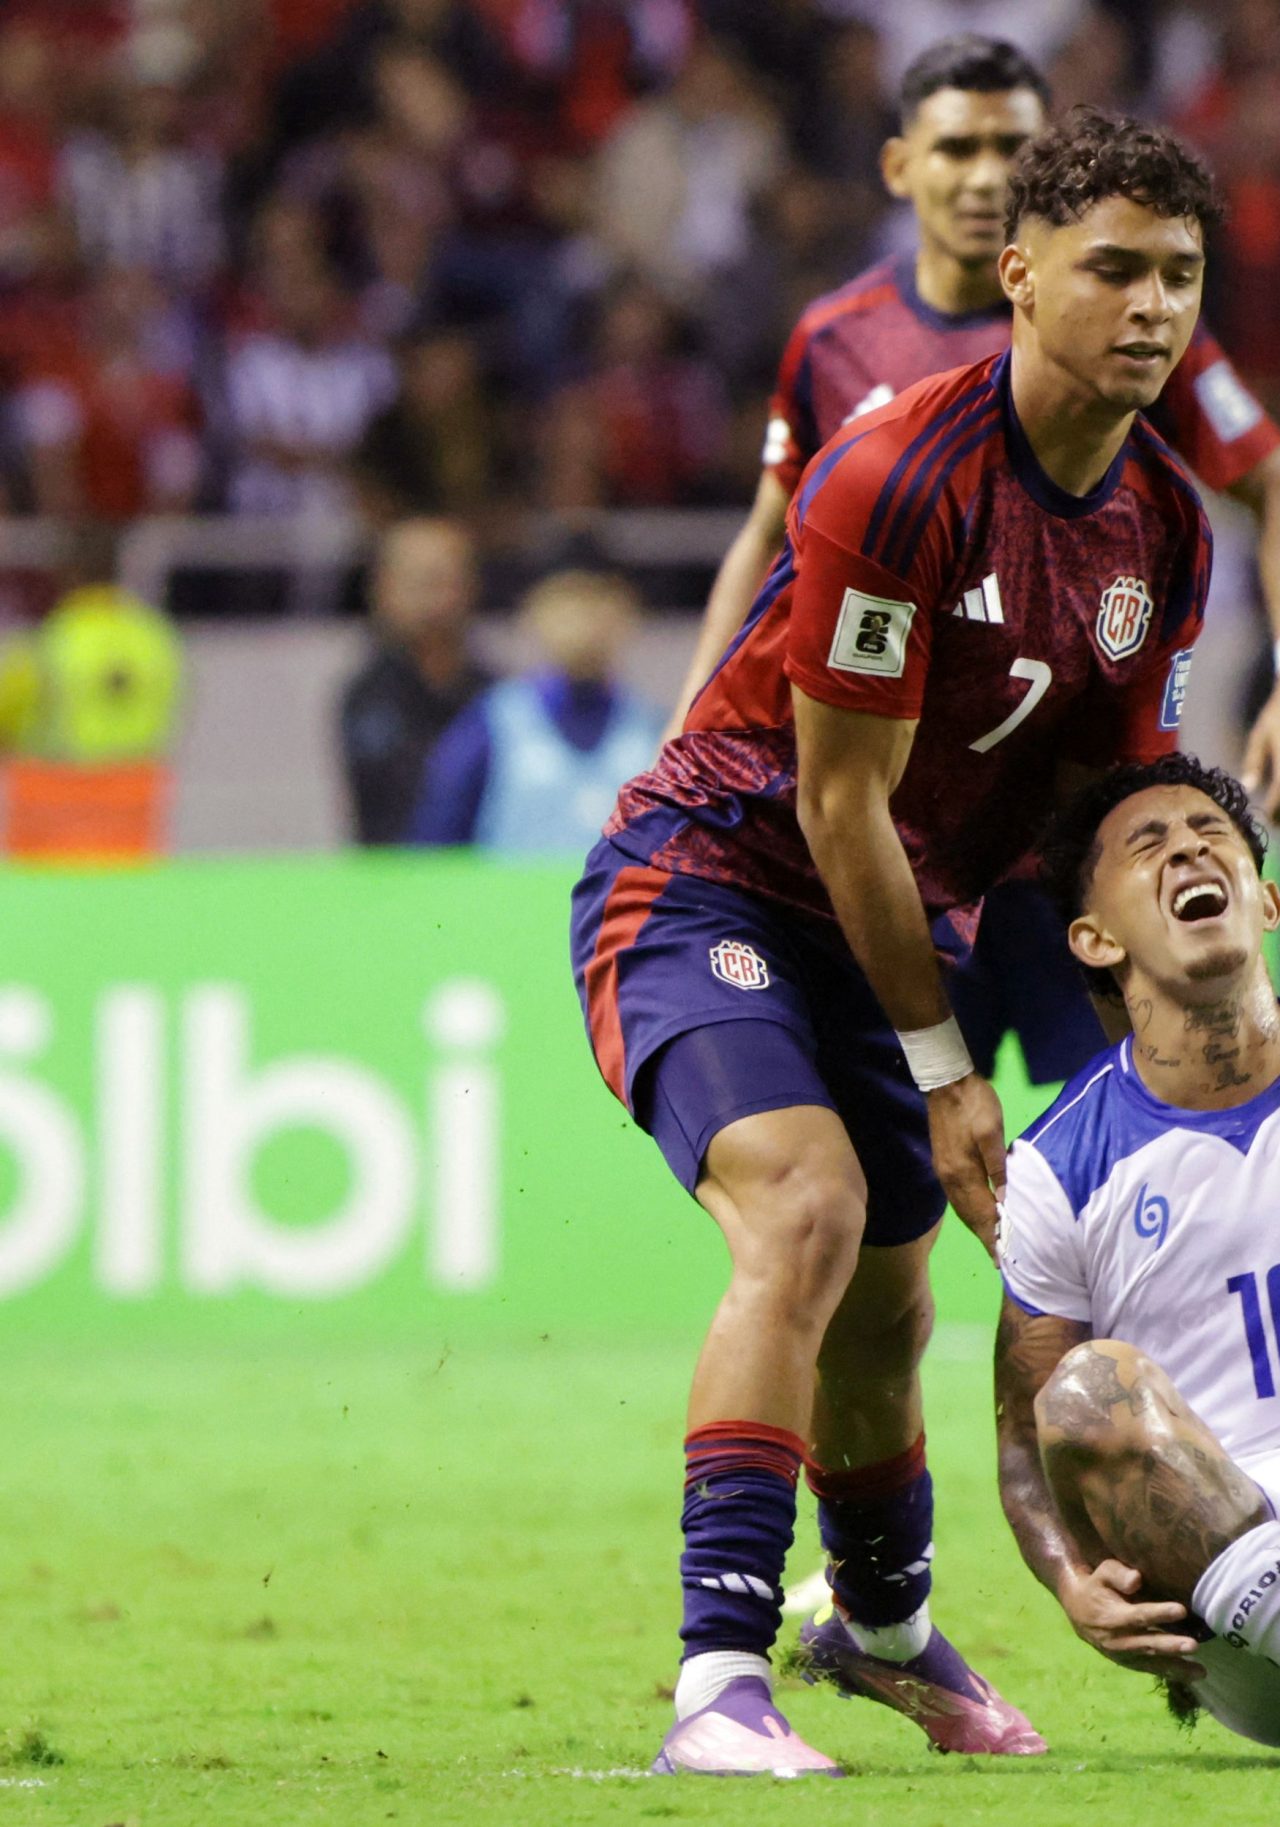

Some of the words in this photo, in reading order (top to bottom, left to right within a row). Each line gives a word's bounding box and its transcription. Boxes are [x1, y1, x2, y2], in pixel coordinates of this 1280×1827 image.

[1107, 594, 1141, 643] CR
[968, 657, 1053, 754] 7
[723, 952, 757, 982] CR
